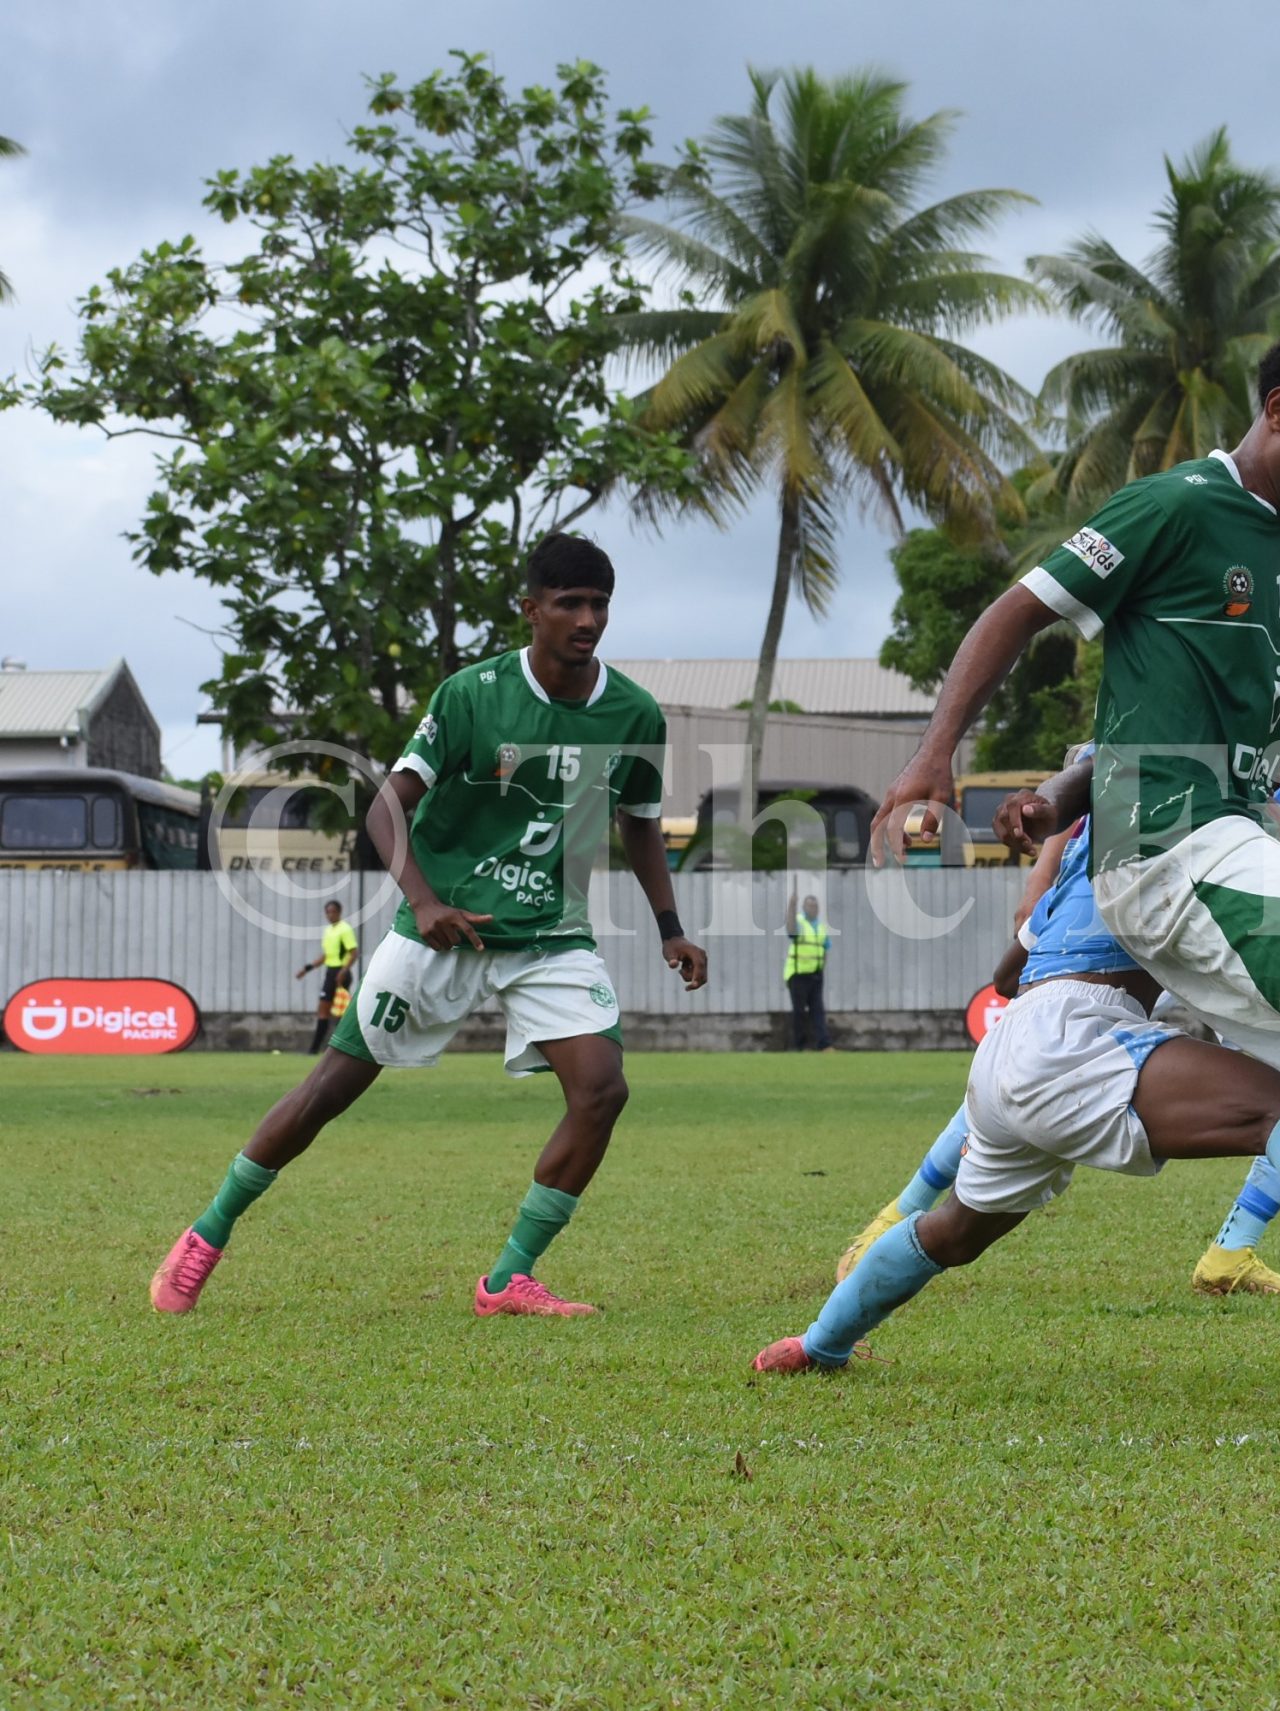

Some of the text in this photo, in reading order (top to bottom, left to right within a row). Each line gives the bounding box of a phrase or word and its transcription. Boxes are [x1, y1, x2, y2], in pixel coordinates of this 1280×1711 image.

[1086, 539, 1115, 571] kids
[547, 744, 582, 782] 15
[229, 856, 273, 871] DEE
[474, 856, 553, 890] Digic
[71, 1006, 178, 1034] Digicel
[370, 990, 411, 1034] 15
[122, 1028, 177, 1040] PACIFIC
